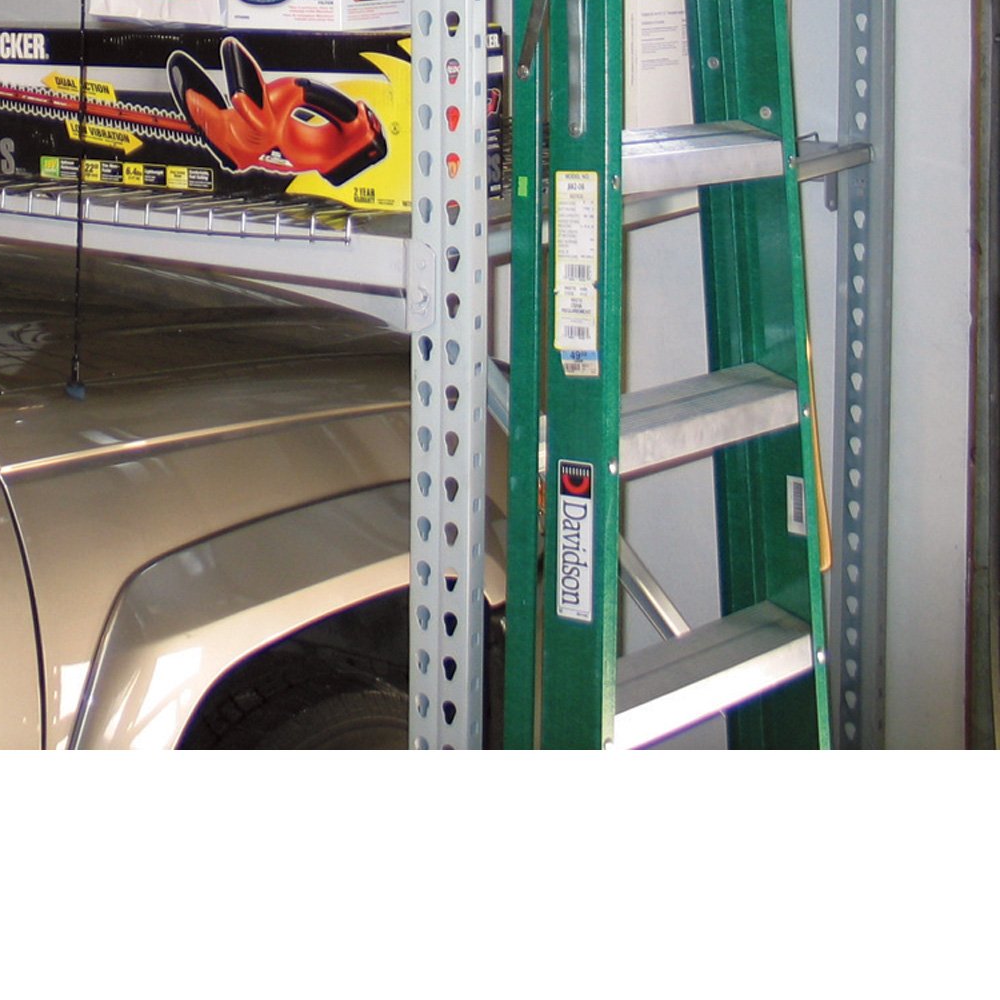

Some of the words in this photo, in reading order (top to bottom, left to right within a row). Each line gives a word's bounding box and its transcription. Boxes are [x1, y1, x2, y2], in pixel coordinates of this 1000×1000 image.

[54, 76, 78, 88] DUAL
[80, 80, 110, 95] CTION
[88, 127, 131, 144] VIBRATION
[560, 501, 589, 606] Davidson
